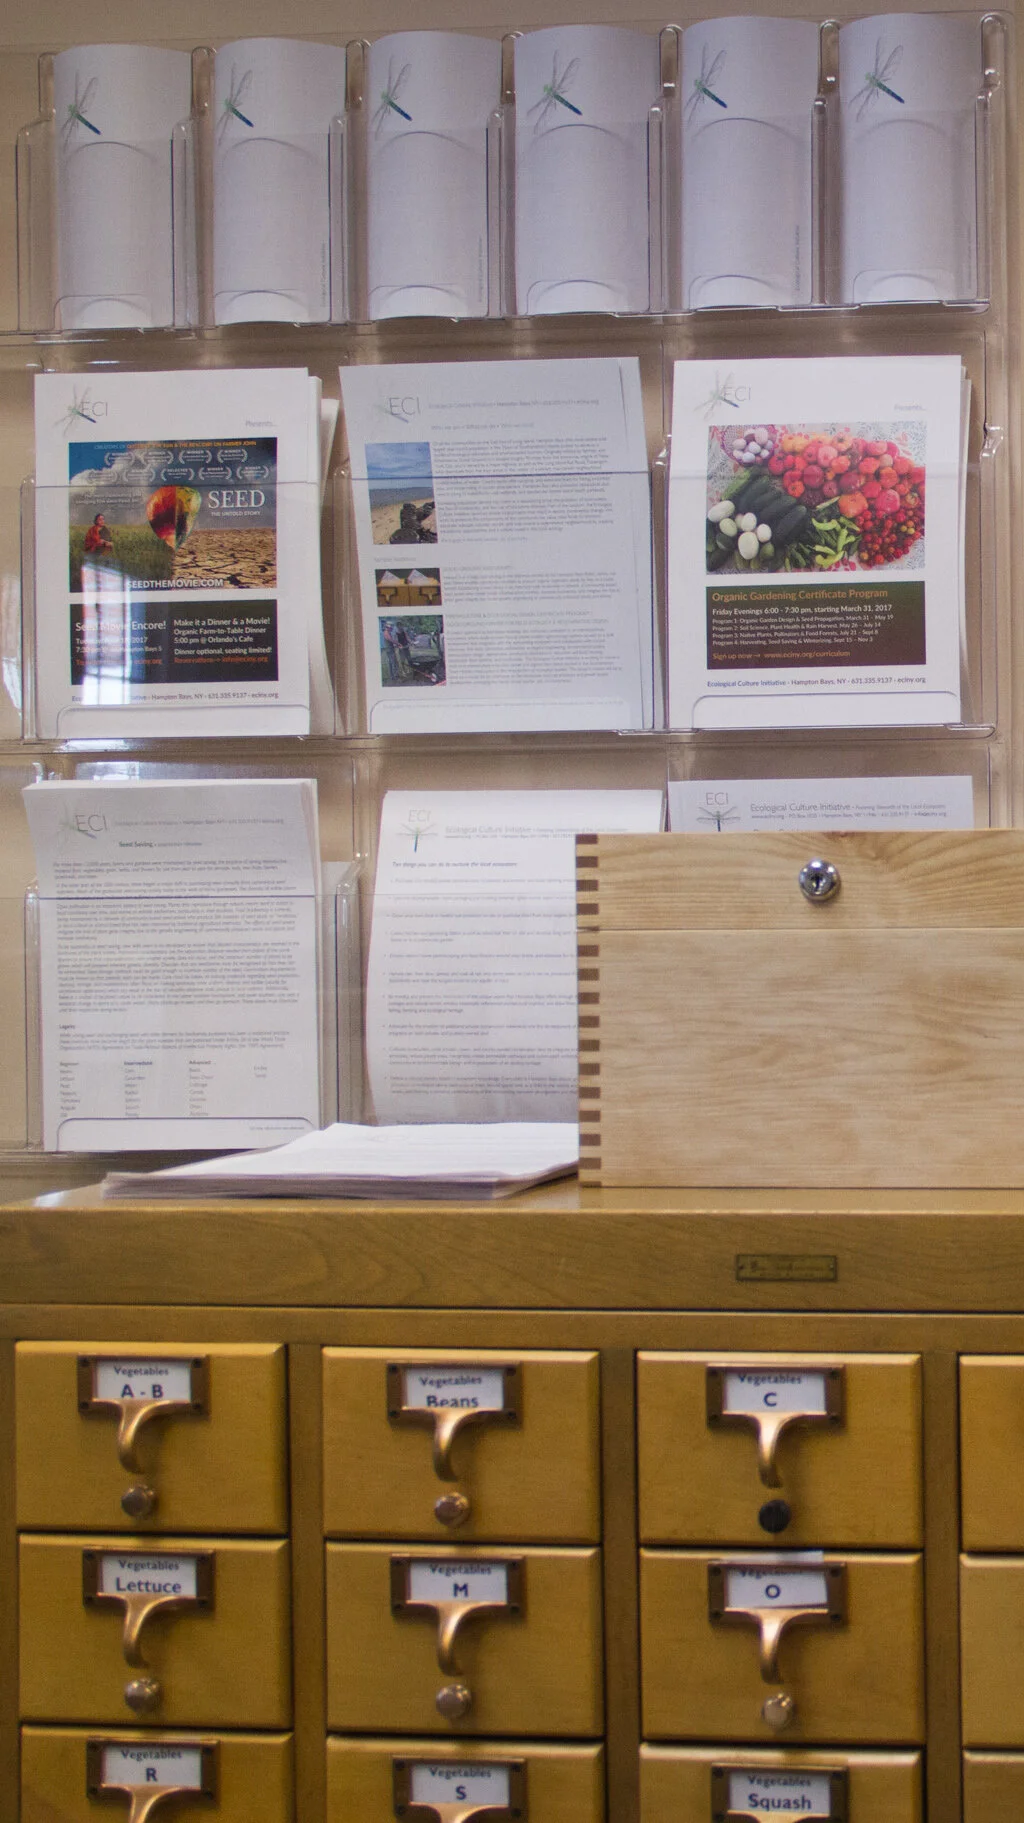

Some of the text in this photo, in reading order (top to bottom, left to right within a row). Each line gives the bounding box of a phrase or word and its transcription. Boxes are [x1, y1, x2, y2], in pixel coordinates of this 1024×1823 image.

[389, 397, 421, 417] ECI
[208, 490, 266, 510] SEED
[712, 590, 889, 604] Organic Gardening Certificate Program
[713, 608, 733, 618] Friday
[734, 608, 763, 618] Evenings
[764, 607, 780, 615] 6:00
[785, 607, 800, 615] 7:30
[814, 606, 840, 615] starting
[841, 605, 863, 614] March
[876, 604, 893, 613] 2017
[132, 621, 167, 631] Encore!
[174, 619, 194, 627] Make
[246, 617, 271, 626] Movie!
[174, 628, 199, 636] Organic
[174, 637, 188, 645] 5:00
[174, 648, 196, 656] Dinner
[225, 648, 248, 656] seating
[708, 680, 737, 689] Ecological
[760, 679, 787, 687] Initiative
[706, 793, 730, 806] ECI
[751, 802, 851, 813] Ecological Culture Initiative
[76, 815, 109, 833] ECI
[115, 1367, 168, 1377] Vegetables
[420, 1376, 481, 1388] Vegetables
[739, 1374, 801, 1386] Vegetables
[121, 1384, 134, 1398] A
[152, 1384, 163, 1398] B
[427, 1395, 478, 1407] Beans
[764, 1392, 777, 1407] C
[119, 1560, 179, 1572] Vegetables
[430, 1564, 491, 1577] Vegetables
[116, 1578, 181, 1593] Lettuce
[453, 1583, 468, 1597] M
[765, 1585, 780, 1599] O
[121, 1749, 181, 1761] Vegetables
[146, 1768, 157, 1781] R
[429, 1767, 491, 1780] Vegetables
[748, 1775, 810, 1788] Vegetables
[456, 1786, 466, 1800] S
[748, 1793, 811, 1810] Squash
